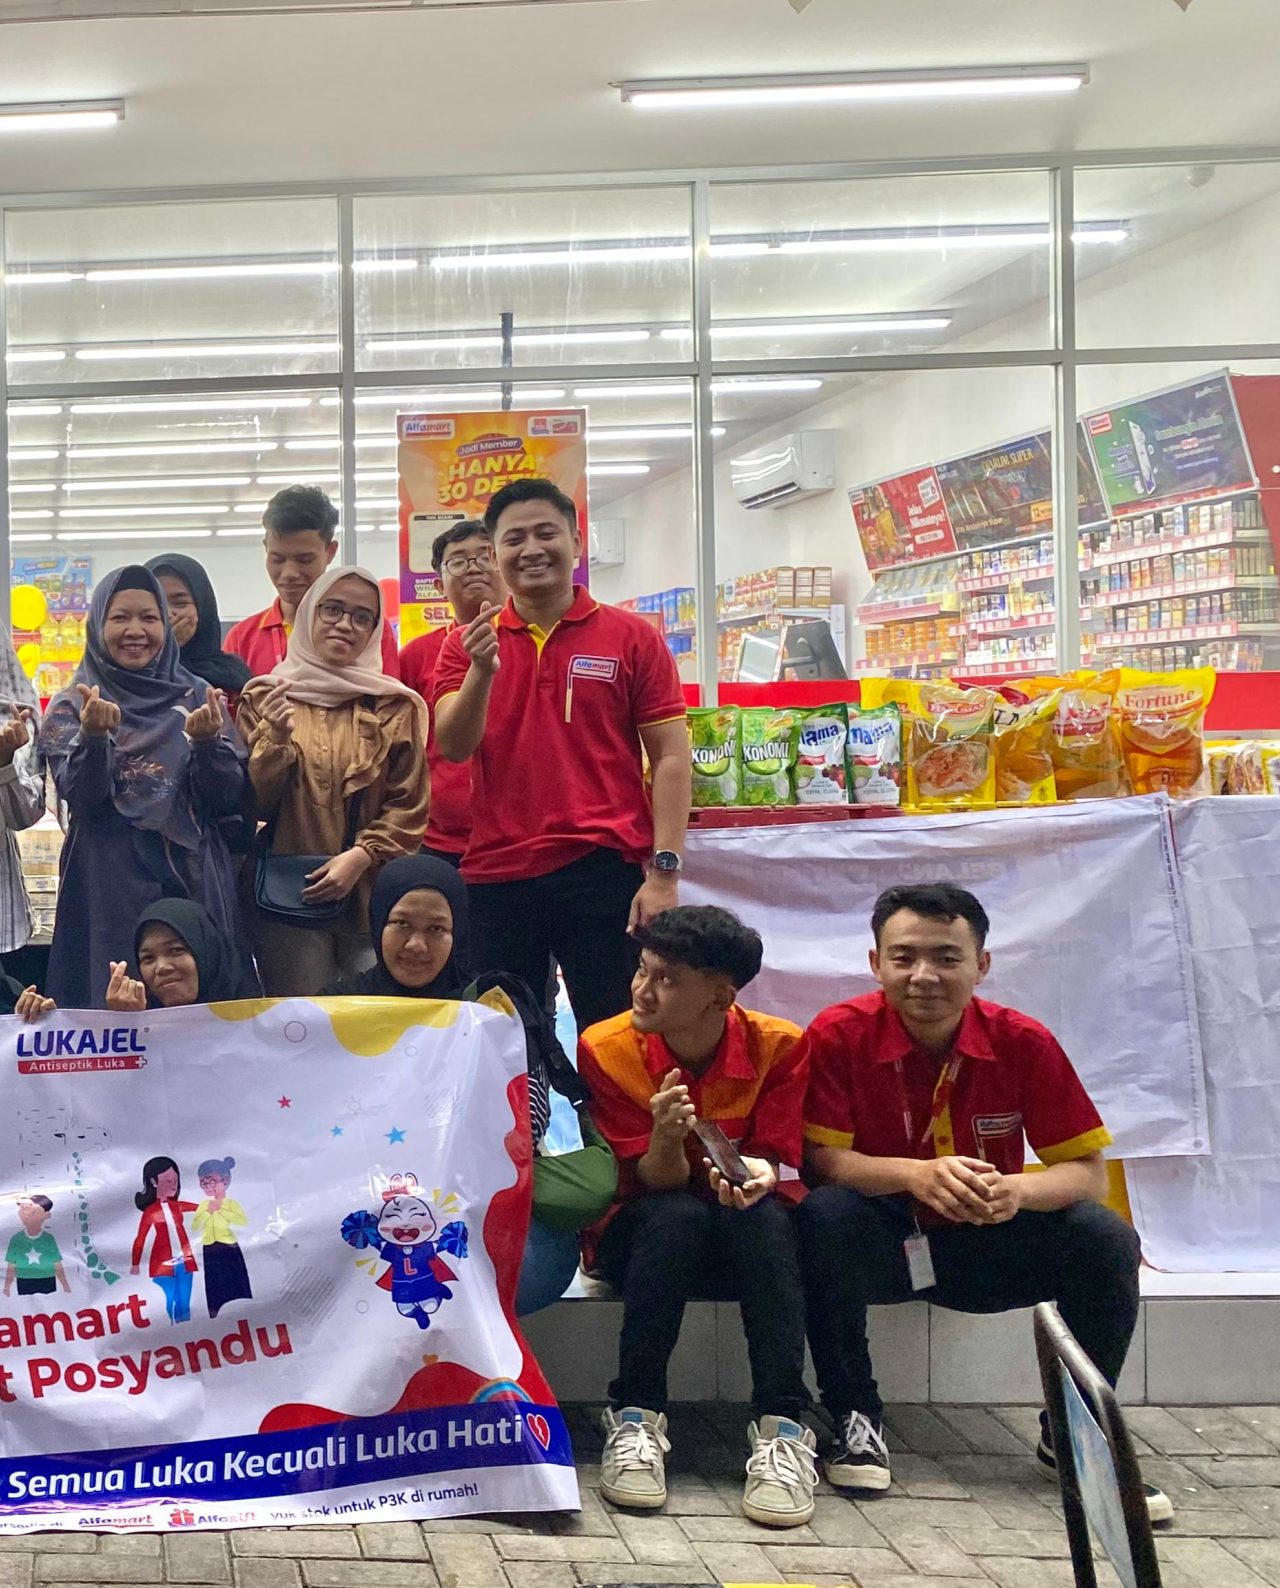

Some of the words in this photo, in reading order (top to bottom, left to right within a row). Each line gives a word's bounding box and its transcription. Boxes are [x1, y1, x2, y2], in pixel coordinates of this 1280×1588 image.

[406, 421, 452, 433] Alfamart
[459, 444, 478, 456] Jadi
[480, 439, 519, 450] Member
[448, 453, 537, 481] HANYA
[437, 482, 468, 504] 30
[575, 660, 613, 671] Alfamart
[1125, 690, 1195, 709] Fortune
[800, 723, 840, 747] ama
[16, 1028, 147, 1057] LUKAJEL
[29, 1057, 93, 1072] Antiseptik
[96, 1057, 126, 1069] Luka
[403, 1258, 418, 1276] L
[28, 1319, 293, 1399] Posyandu
[7, 1469, 125, 1499] Semua
[133, 1456, 214, 1488] Luka
[223, 1436, 347, 1480] Kecuali
[356, 1425, 438, 1463] Luka
[448, 1414, 522, 1448] Hati
[78, 1514, 154, 1525] Alfamart
[198, 1511, 257, 1524] Alfagift
[334, 1497, 377, 1515] untuk
[378, 1493, 408, 1508] P3K
[411, 1489, 425, 1503] di
[427, 1484, 479, 1502] rumah!
